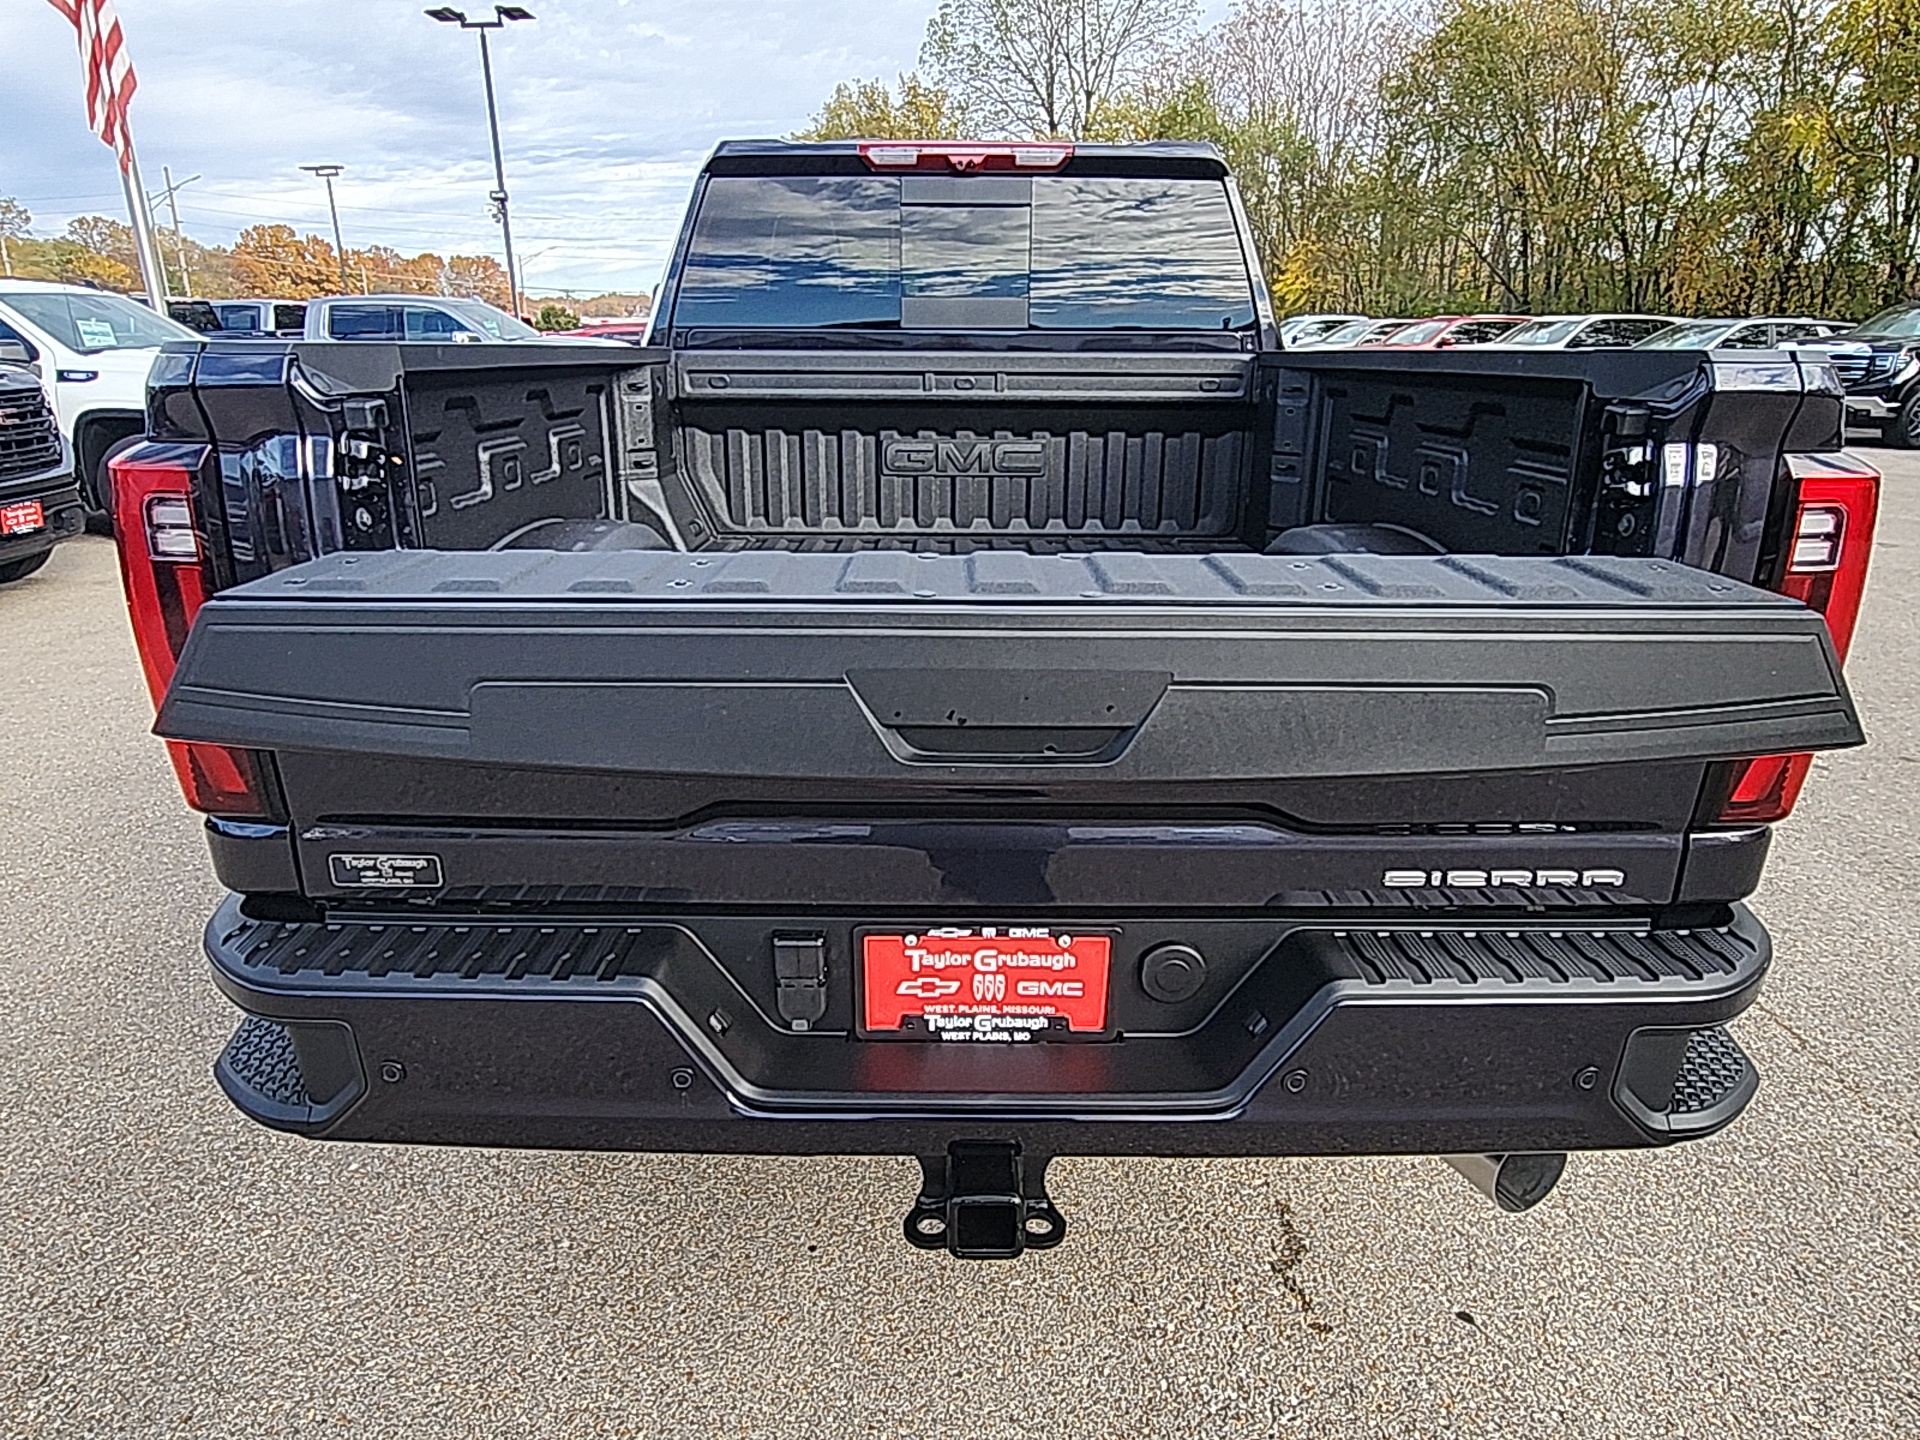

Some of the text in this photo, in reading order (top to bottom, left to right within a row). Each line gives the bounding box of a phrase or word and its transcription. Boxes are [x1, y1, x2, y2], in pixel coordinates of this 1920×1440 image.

[884, 442, 1044, 474] GMC
[1382, 869, 1625, 887] SIERRA
[1008, 927, 1050, 938] GMC
[904, 949, 1076, 972] Taylor Grubaugh
[1016, 981, 1084, 996] GMC
[923, 1004, 1056, 1015] WEST PLAINS, MISSOURI
[923, 1014, 1049, 1032] Taylor Grubaugh
[940, 1031, 971, 1041] WEST
[1013, 1031, 1032, 1041] MO
